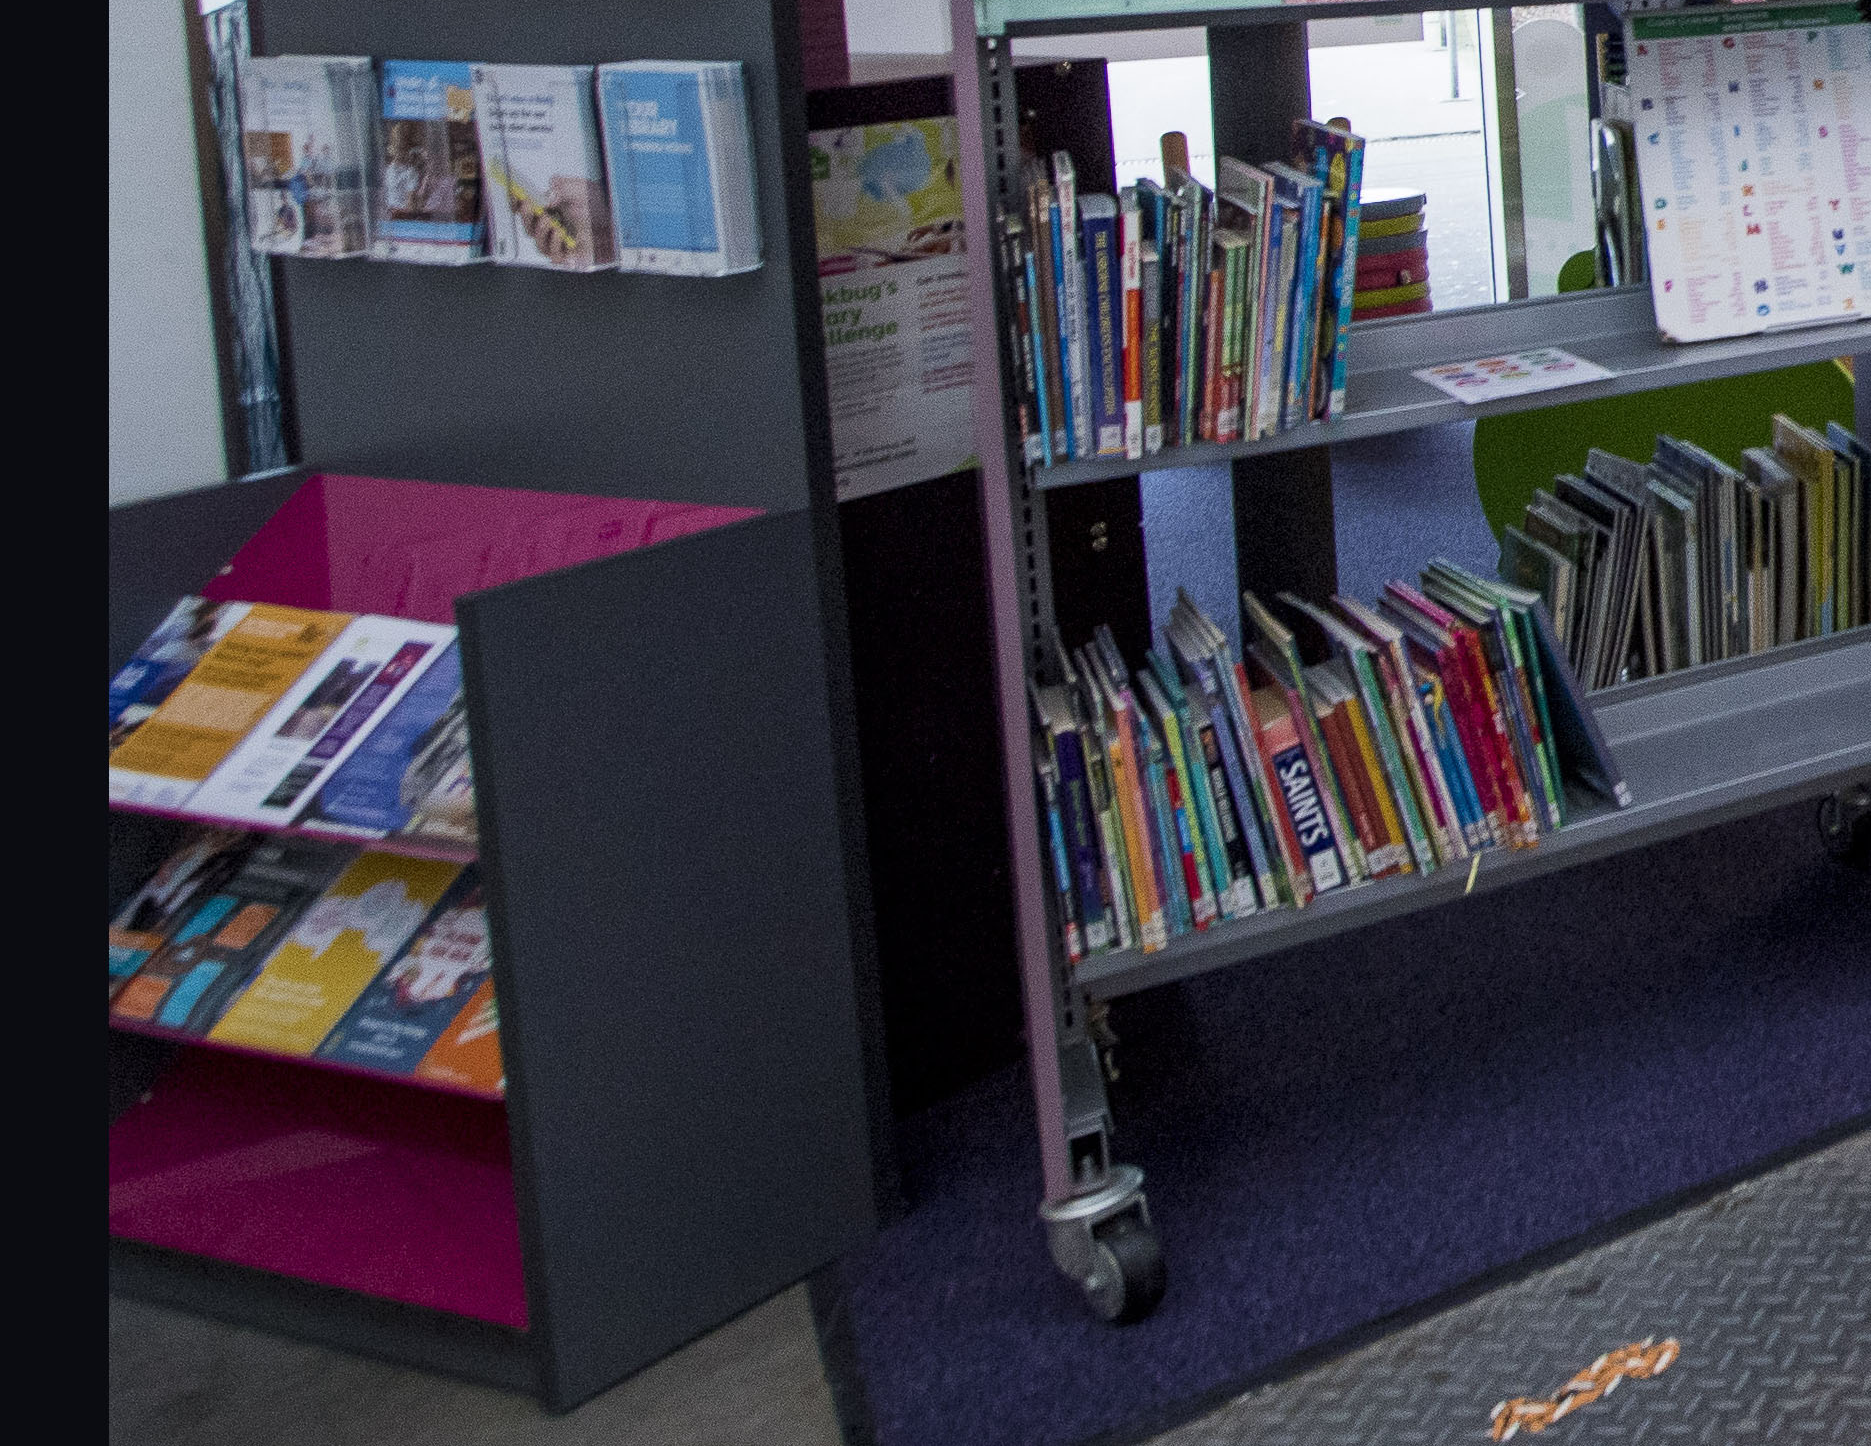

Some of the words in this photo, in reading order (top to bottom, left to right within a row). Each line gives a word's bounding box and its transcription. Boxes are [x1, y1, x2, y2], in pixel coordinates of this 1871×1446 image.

[825, 279, 899, 306] kbug's
[824, 306, 863, 328] ary
[826, 320, 899, 346] llenge
[1280, 760, 1331, 846] SAINTS
